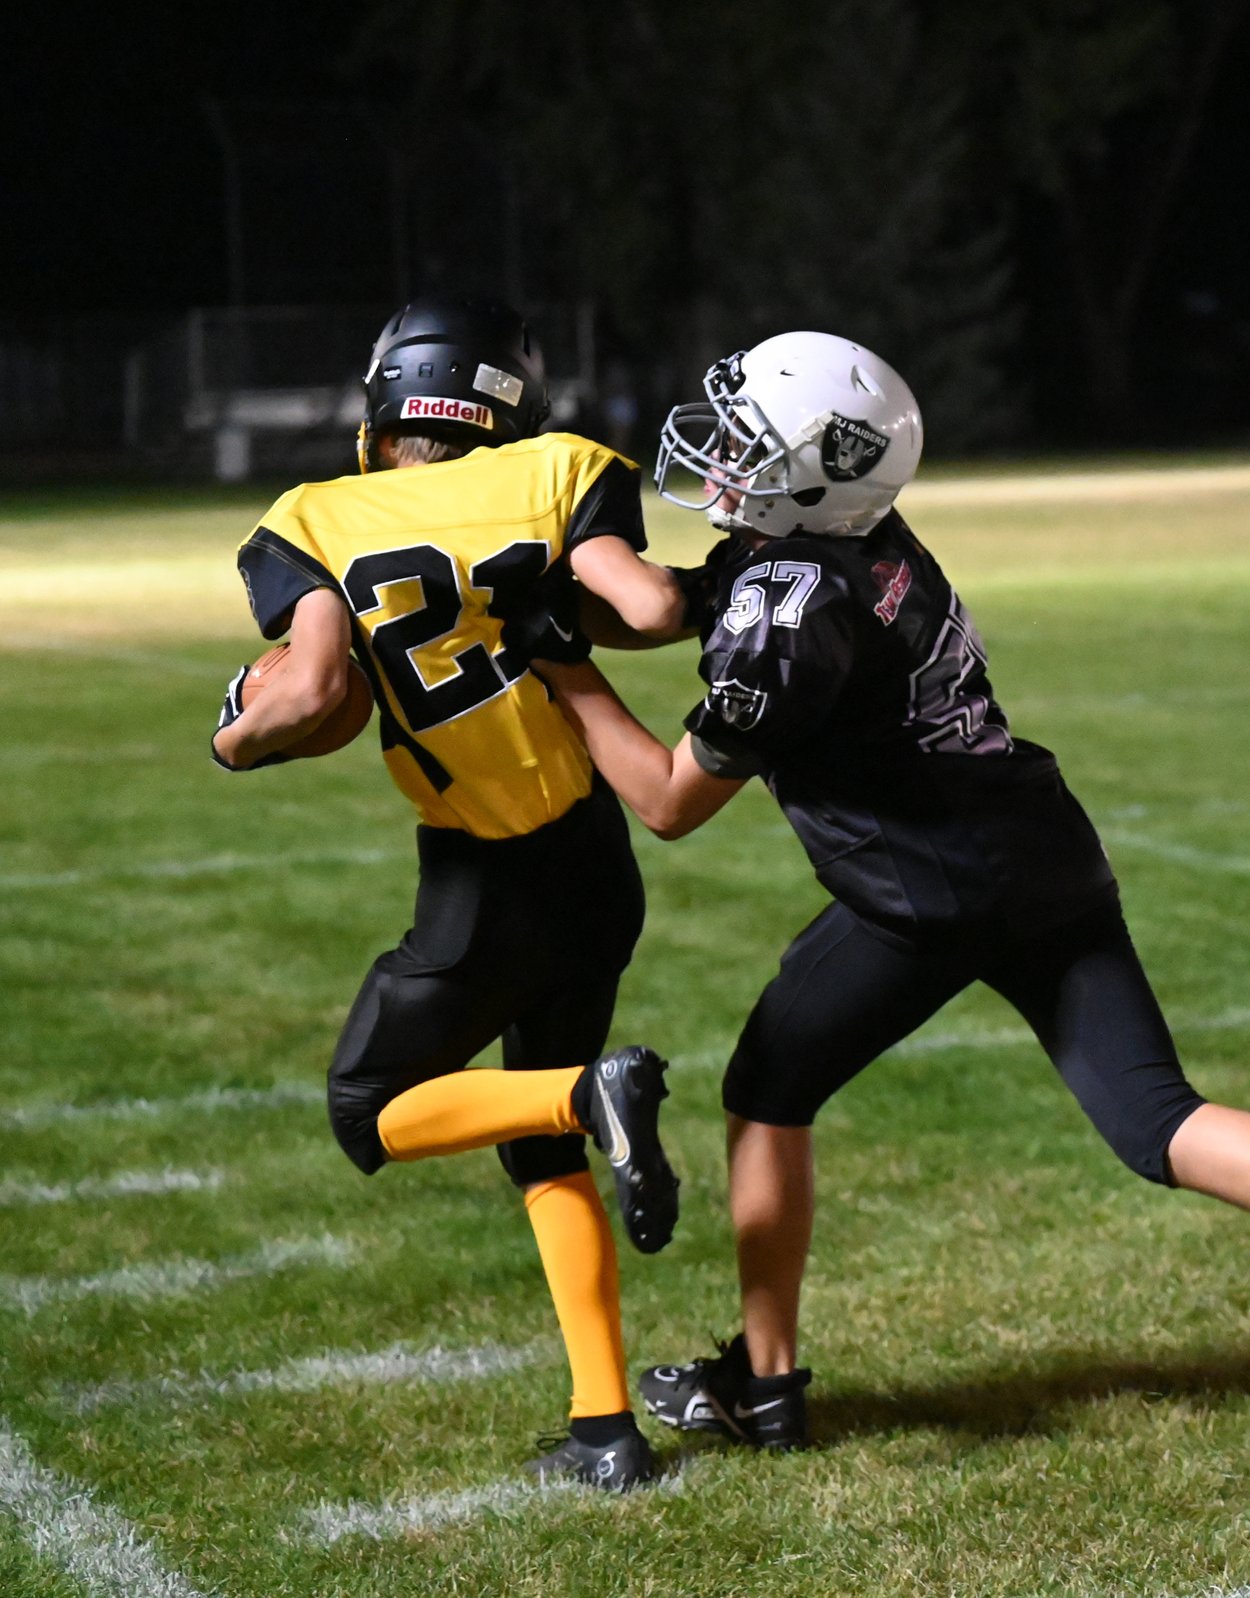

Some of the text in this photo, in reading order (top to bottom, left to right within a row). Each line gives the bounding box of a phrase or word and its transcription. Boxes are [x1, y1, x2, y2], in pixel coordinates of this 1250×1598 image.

[407, 398, 489, 426] Riddell
[847, 423, 887, 448] RAIDERS
[722, 560, 821, 635] 57
